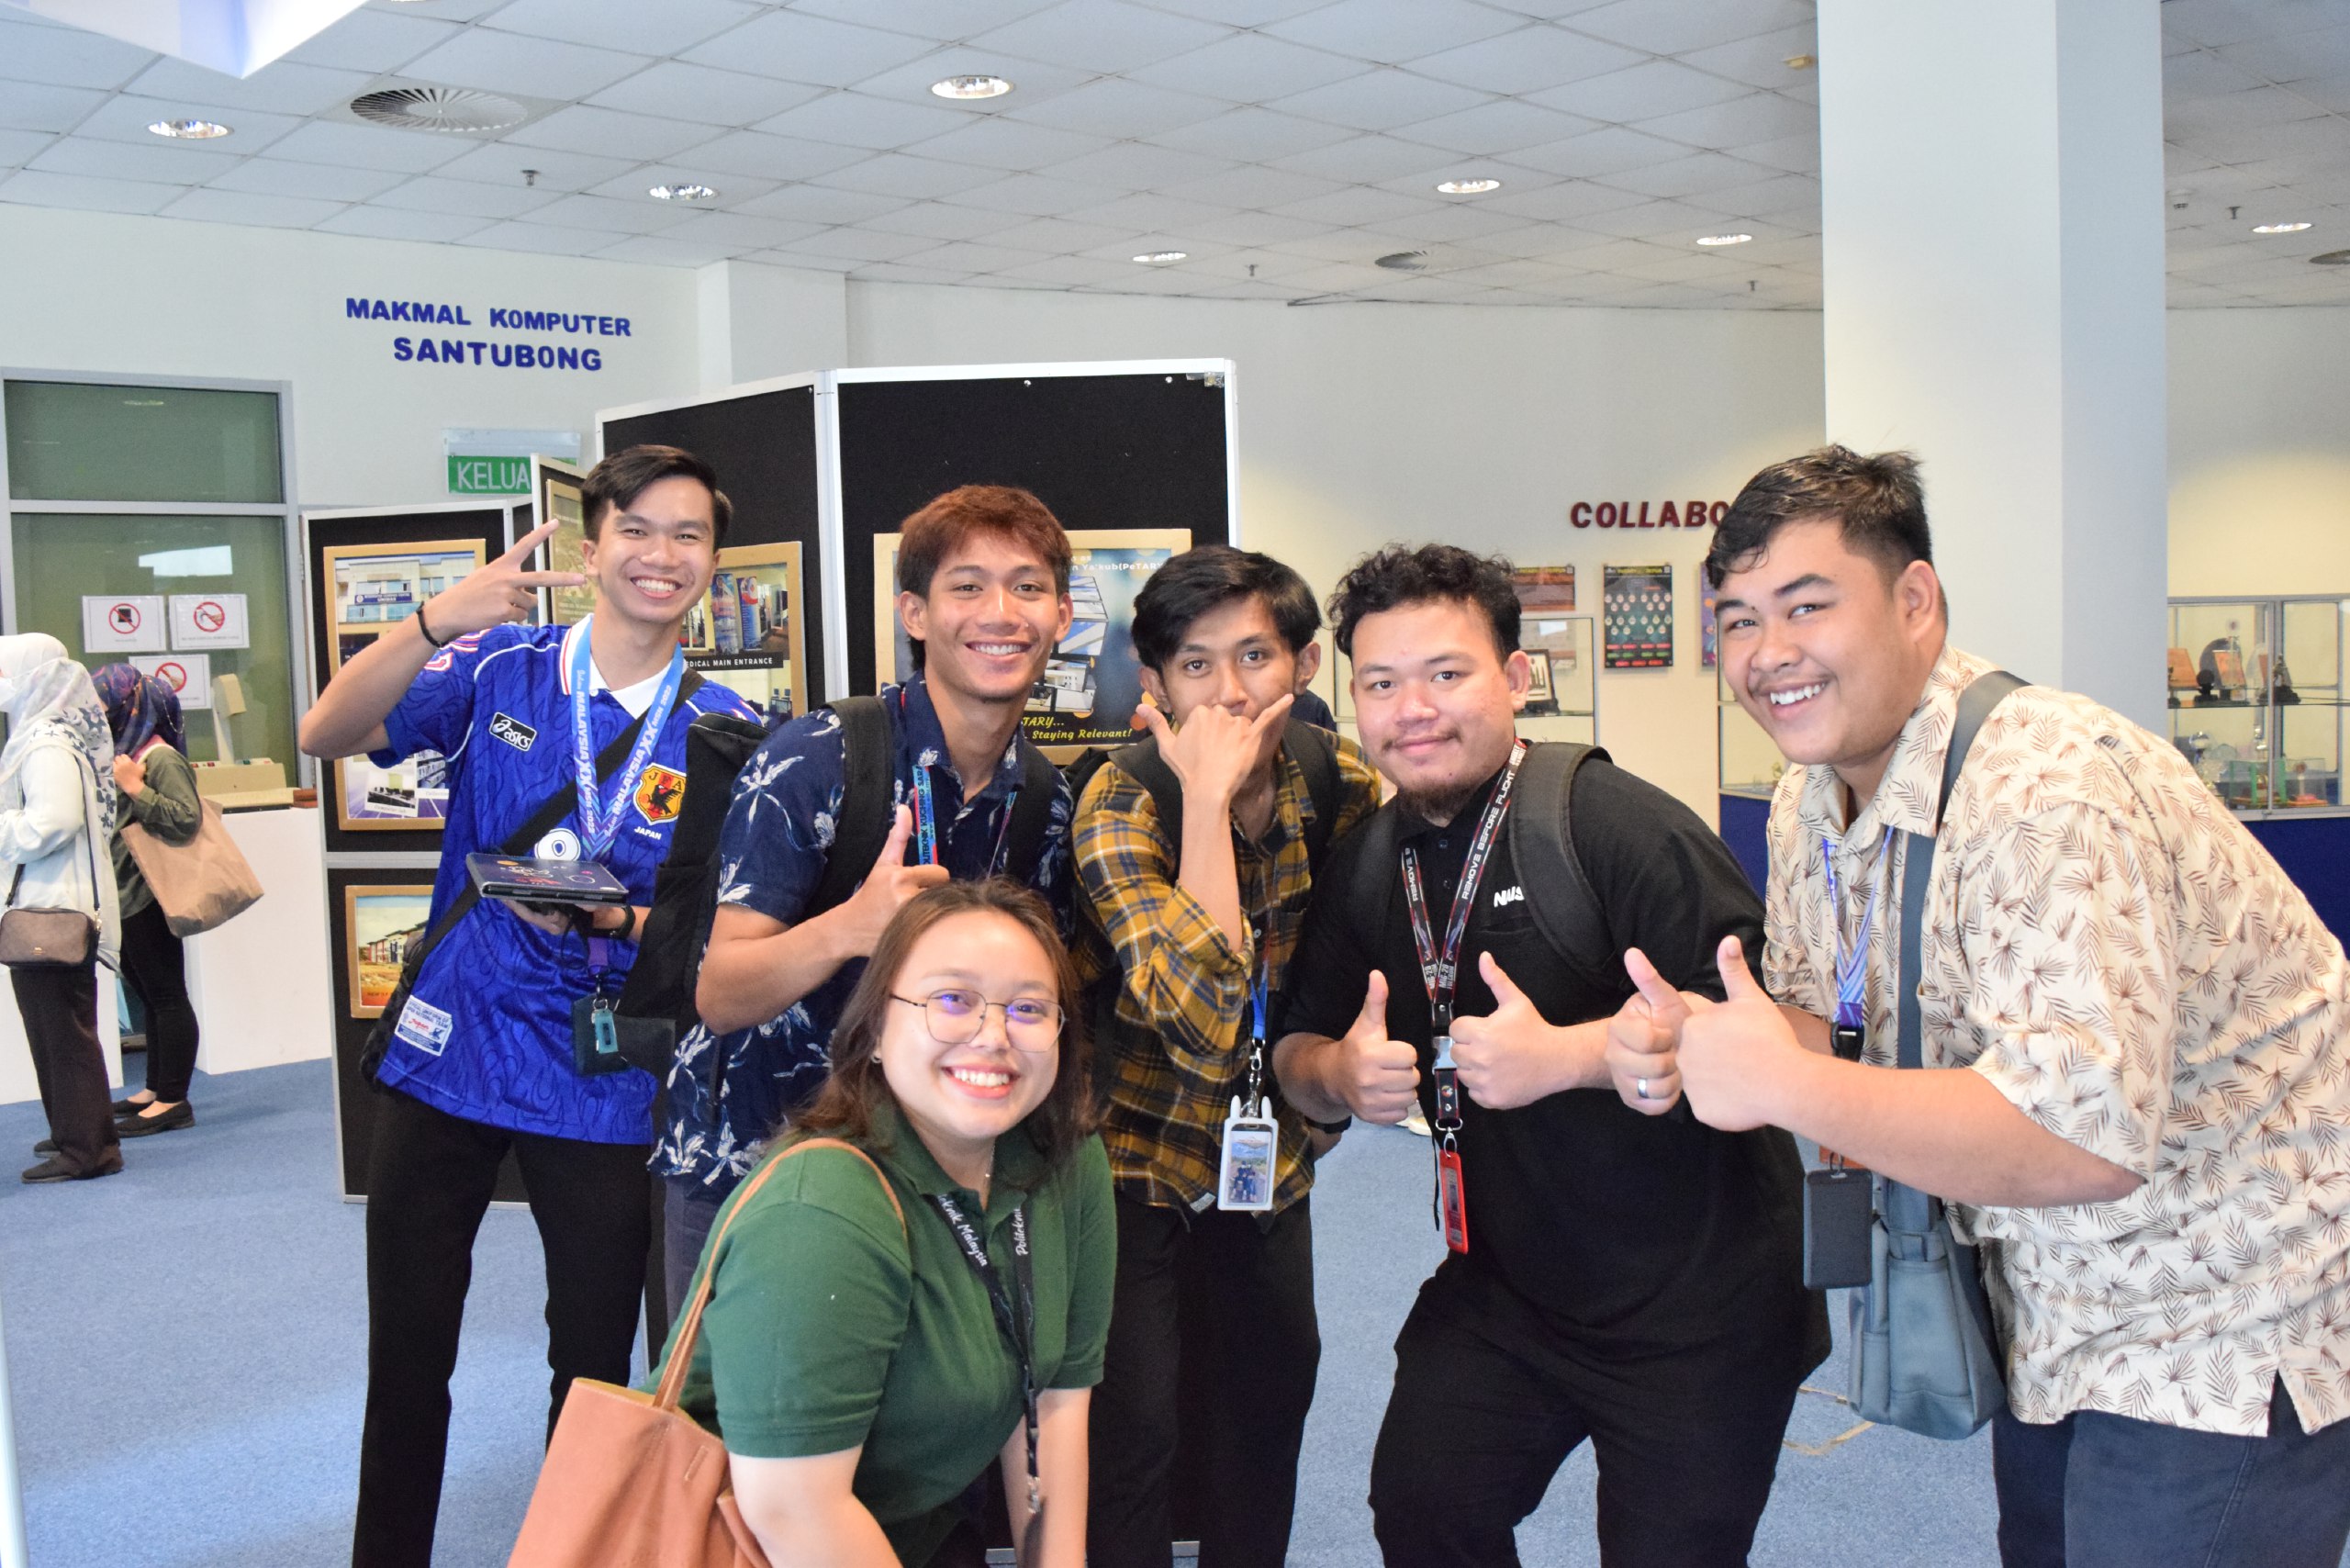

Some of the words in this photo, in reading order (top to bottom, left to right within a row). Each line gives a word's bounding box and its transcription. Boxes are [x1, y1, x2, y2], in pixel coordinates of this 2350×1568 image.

[346, 297, 472, 326] MAKMAL
[490, 308, 632, 337] KOMPUTER
[394, 337, 602, 371] SANTUBONG
[734, 657, 773, 666] ENTRANCE
[576, 691, 590, 761] MALAYSIA
[1032, 730, 1074, 741] Staying
[1078, 728, 1133, 739] Relevant!
[611, 748, 645, 815] MALAYSIA
[634, 825, 662, 841] JAPAN
[1461, 853, 1482, 901] REMOVE
[1477, 807, 1500, 850] BEFORE
[1495, 769, 1516, 805] FLIGHT
[1406, 858, 1419, 902] REMOVE
[957, 1219, 988, 1268] Malaysia
